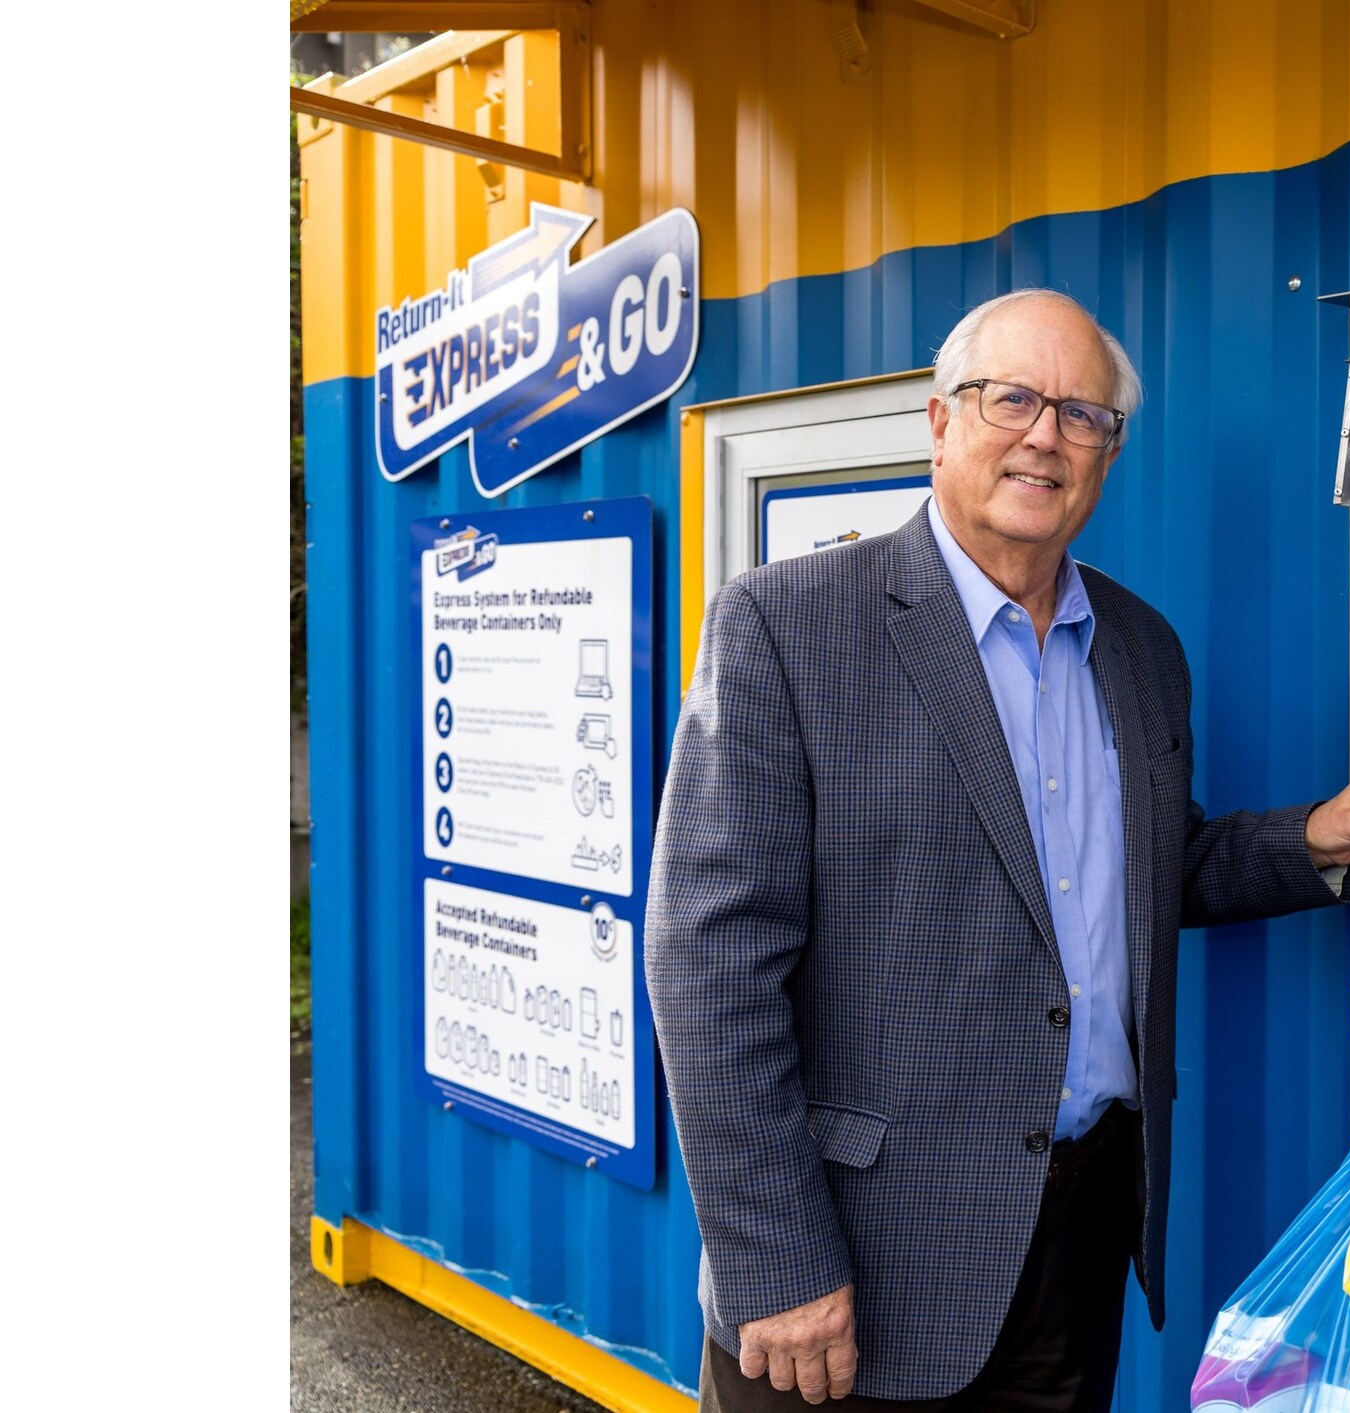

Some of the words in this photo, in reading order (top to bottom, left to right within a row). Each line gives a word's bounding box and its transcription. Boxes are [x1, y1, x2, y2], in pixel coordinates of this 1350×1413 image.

[377, 276, 465, 353] Return-It
[404, 292, 540, 428] EXPRESS
[434, 592, 471, 609] Express
[474, 591, 509, 610] System
[513, 589, 527, 605] for
[530, 587, 592, 605] Refundable
[434, 614, 478, 634] Beverage
[481, 613, 535, 630] Containers
[538, 613, 562, 634] Only
[438, 649, 448, 677] 1
[438, 704, 450, 732] 2
[438, 759, 450, 787] 3
[438, 813, 450, 841] 4
[436, 899, 477, 923] Accepted
[480, 908, 537, 938] Refundable
[436, 920, 480, 948] Beverage
[483, 932, 537, 961] Containers
